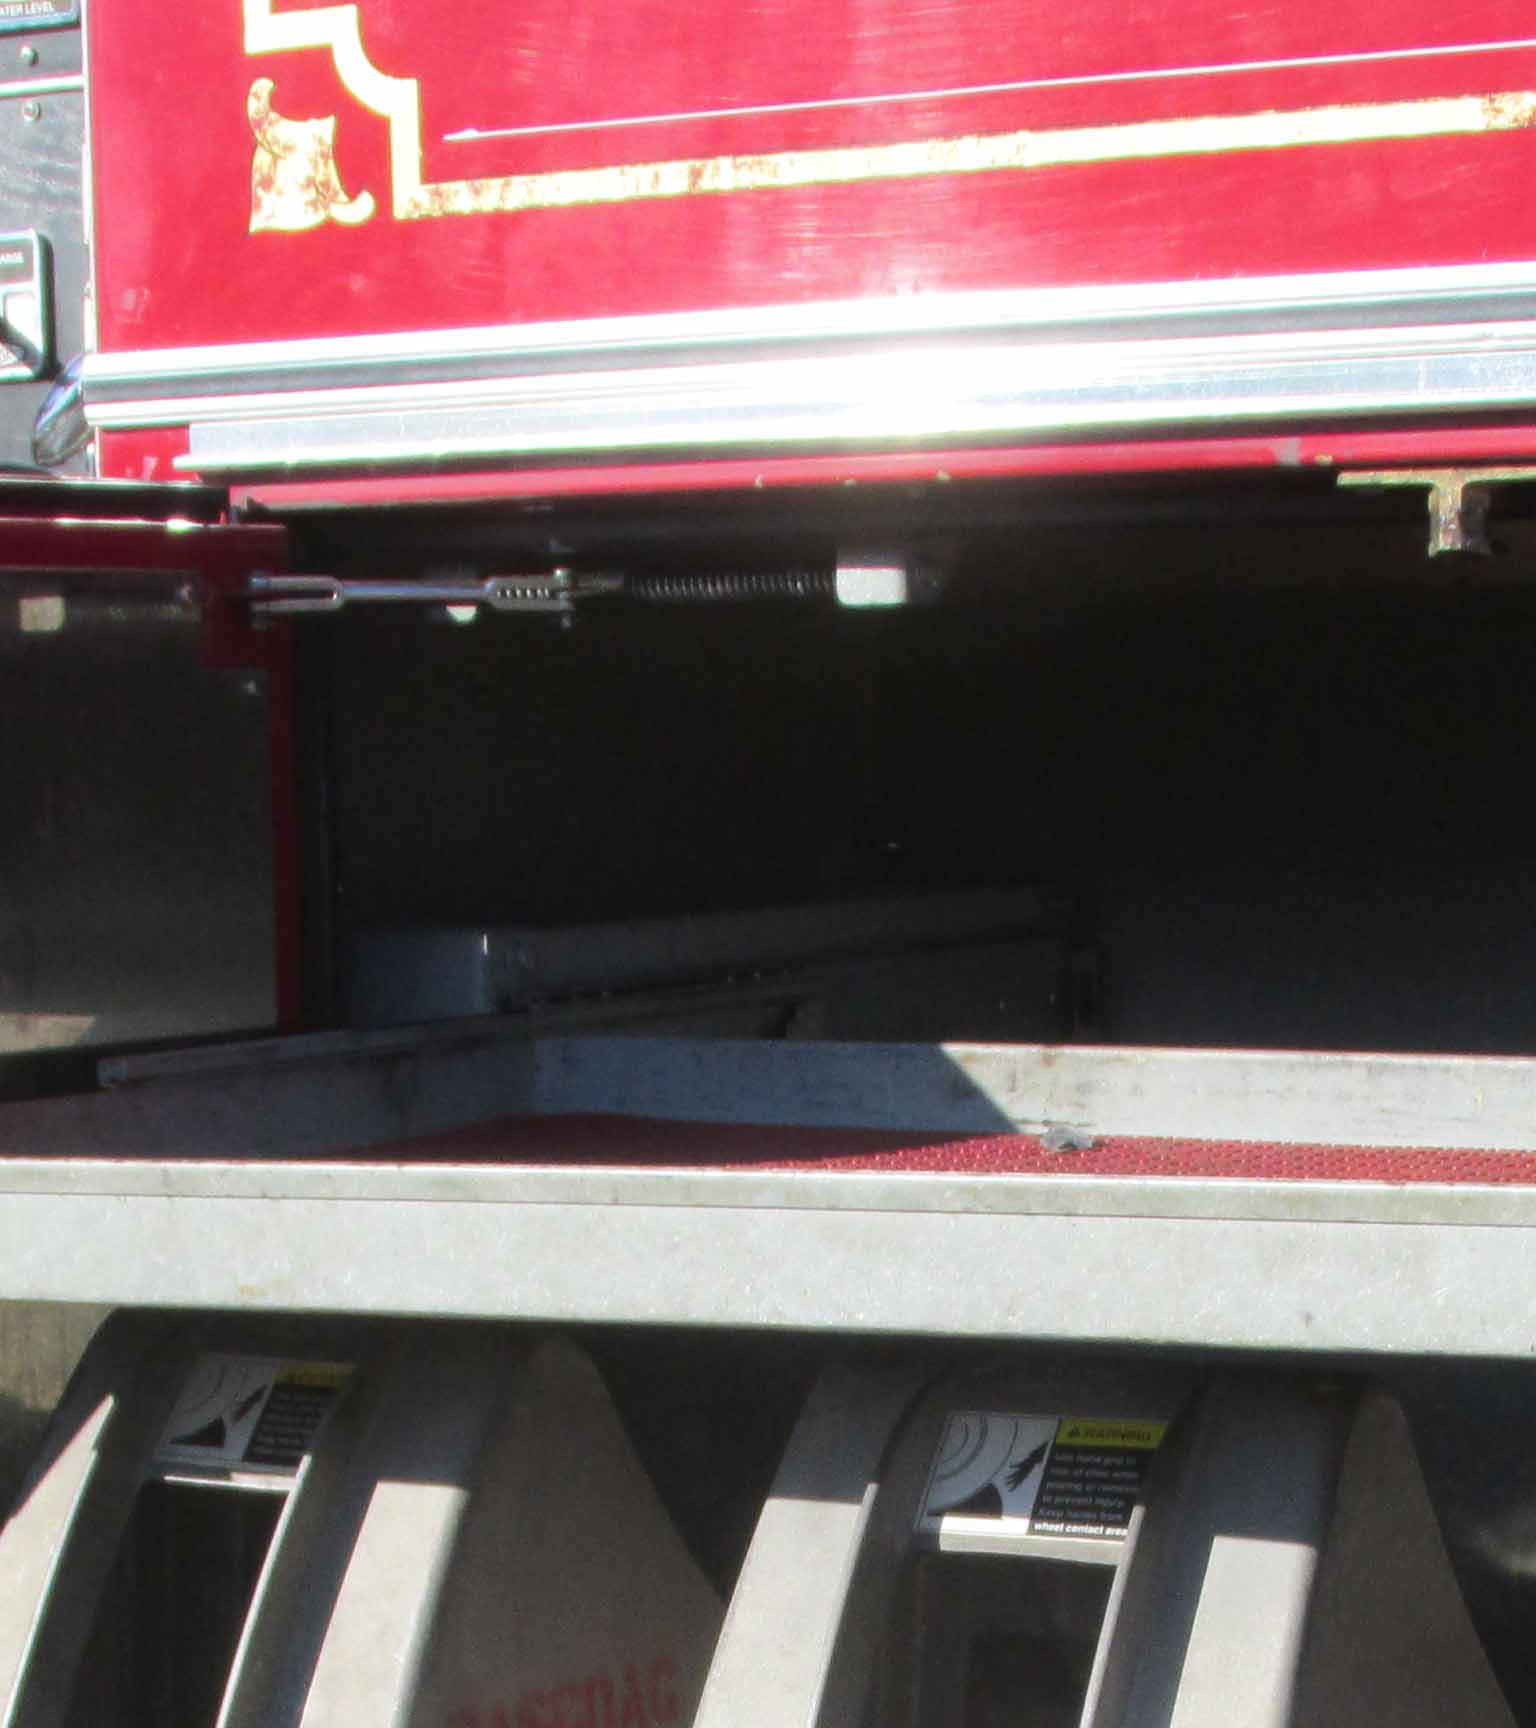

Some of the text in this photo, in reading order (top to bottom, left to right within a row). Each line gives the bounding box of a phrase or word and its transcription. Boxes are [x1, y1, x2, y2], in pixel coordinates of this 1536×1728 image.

[24, 1, 53, 16] LEVEL
[1034, 1522, 1064, 1533] wheel
[1065, 1523, 1104, 1535] contact
